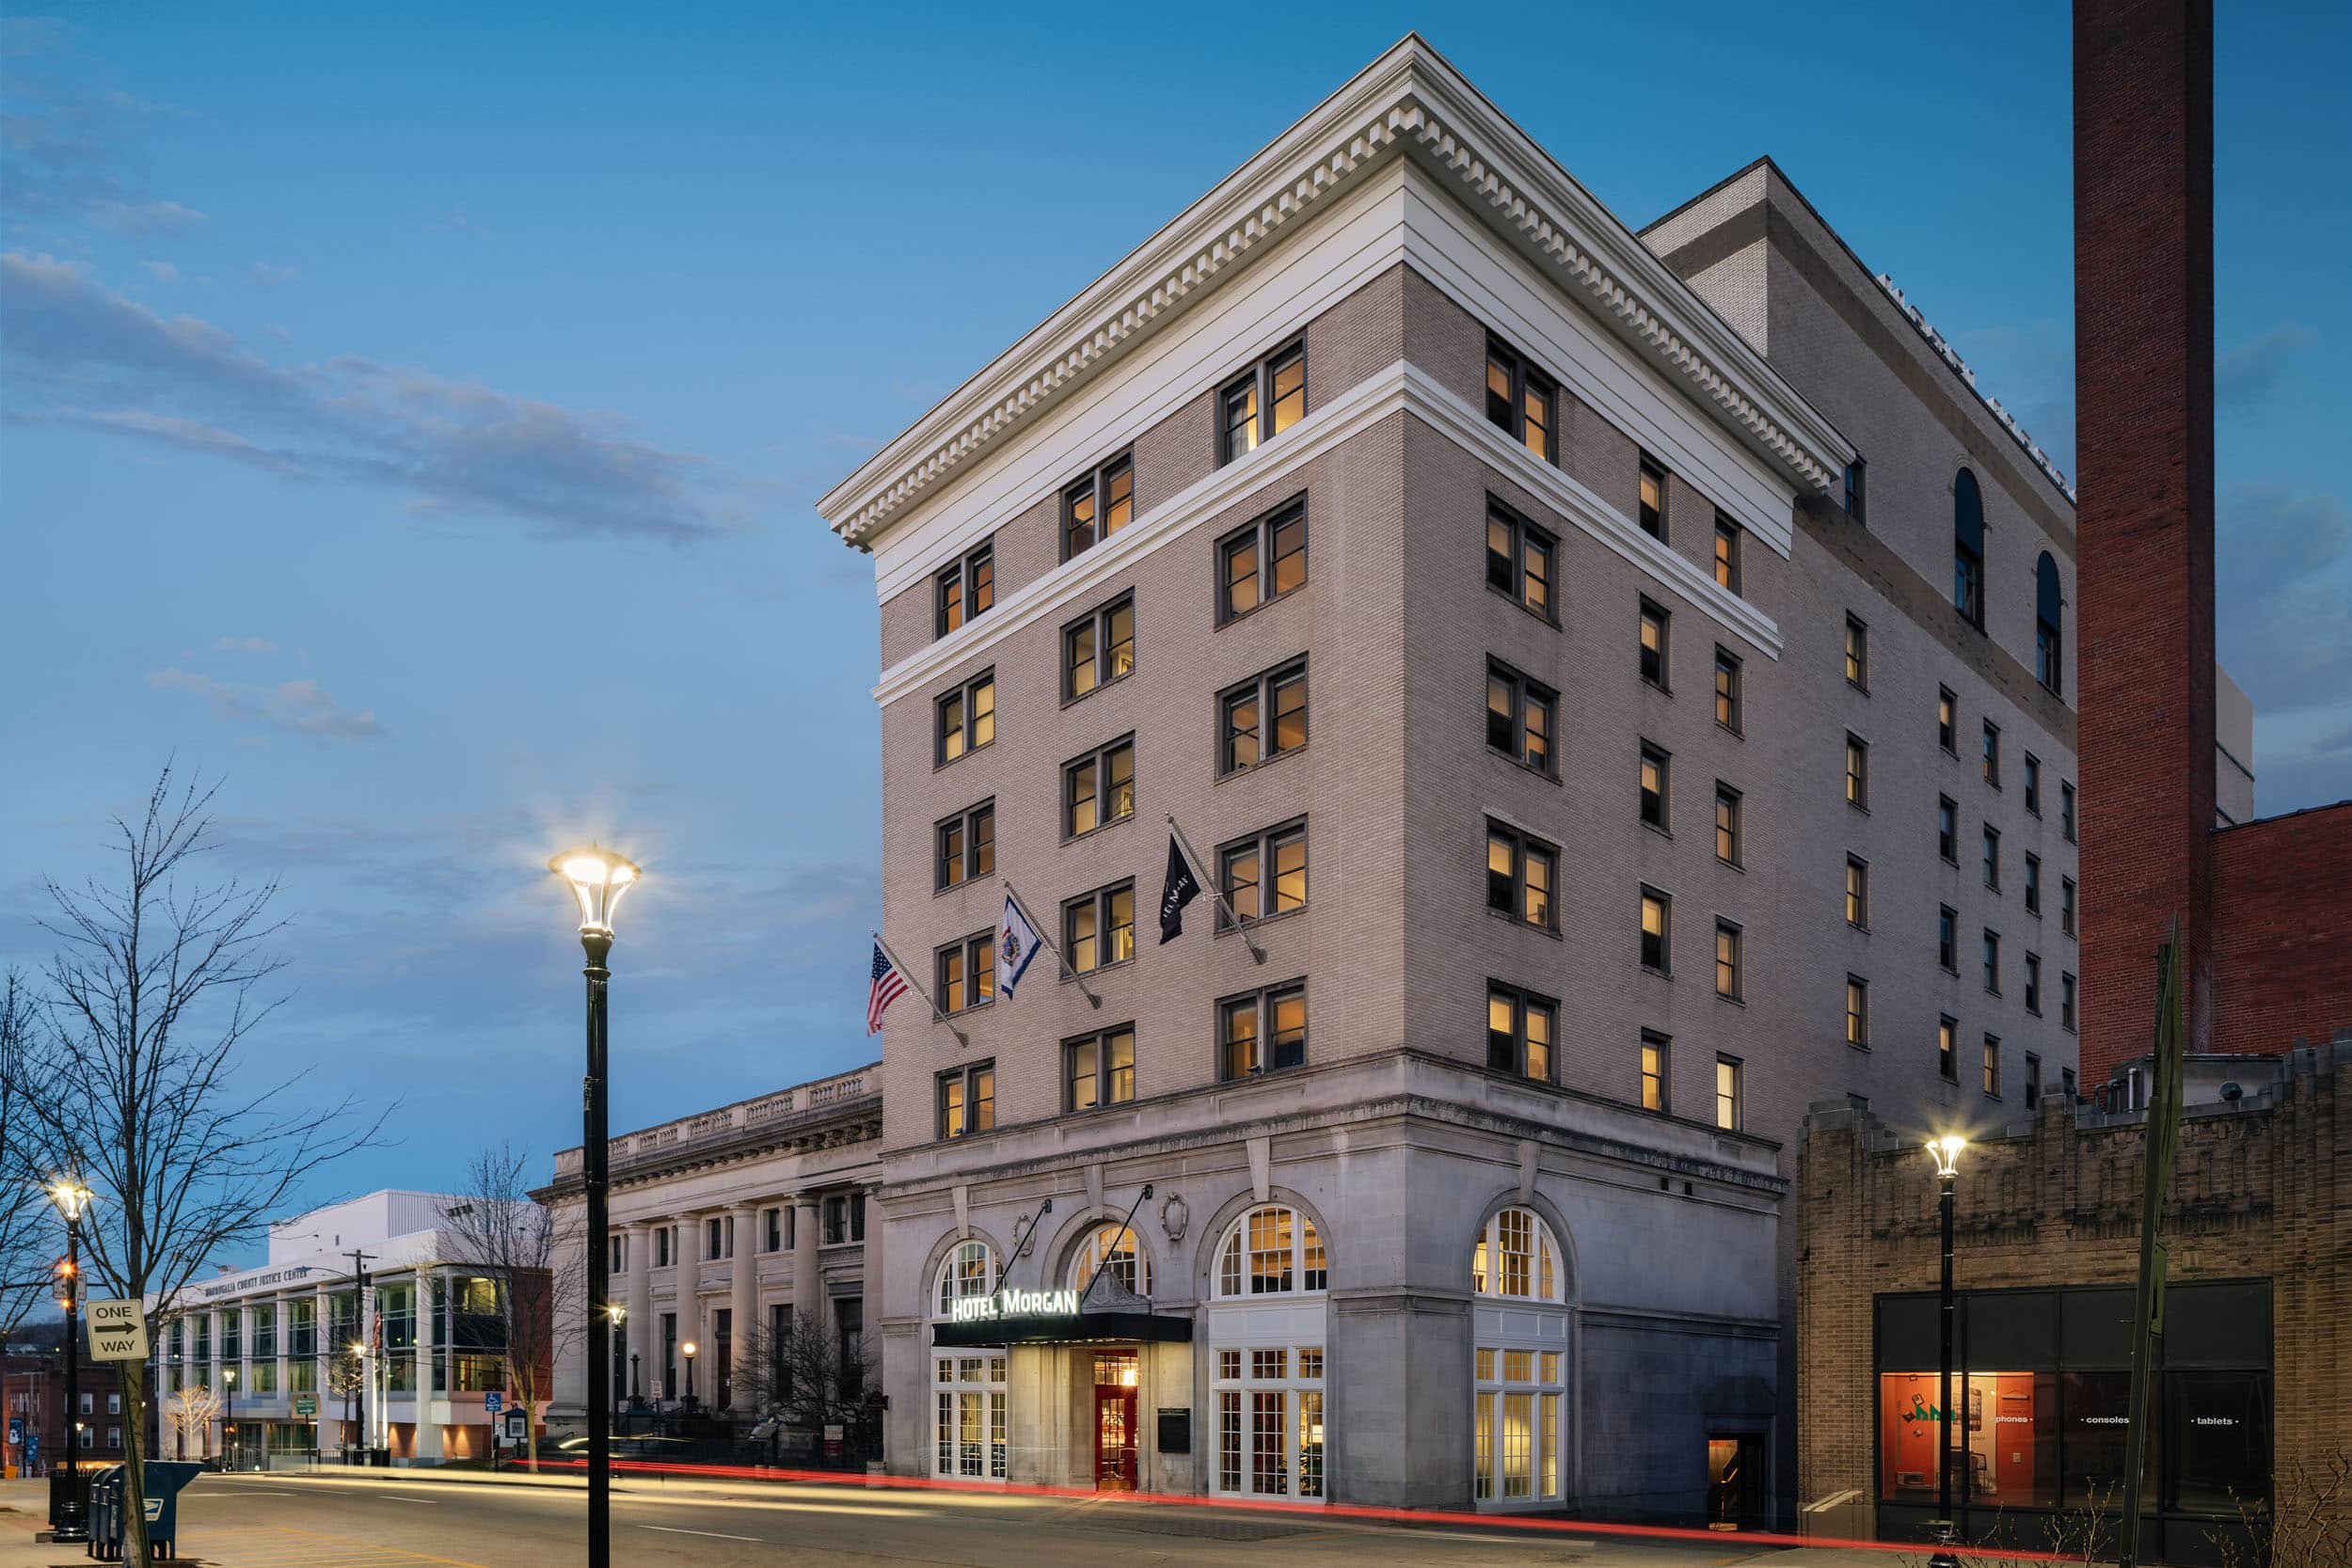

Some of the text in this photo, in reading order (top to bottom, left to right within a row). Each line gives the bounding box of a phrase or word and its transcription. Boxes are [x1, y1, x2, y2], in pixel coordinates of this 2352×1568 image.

[237, 1276, 258, 1291] COUNTY
[259, 1273, 281, 1286] JUSTICE
[283, 1268, 308, 1281] CENTER
[96, 1306, 133, 1319] ONE
[952, 1289, 1077, 1323] HOTEL MORGAN
[101, 1339, 135, 1353] WAY
[1995, 1415, 2028, 1424] phones
[2086, 1416, 2130, 1424] consoles
[2197, 1417, 2233, 1426] tablets
